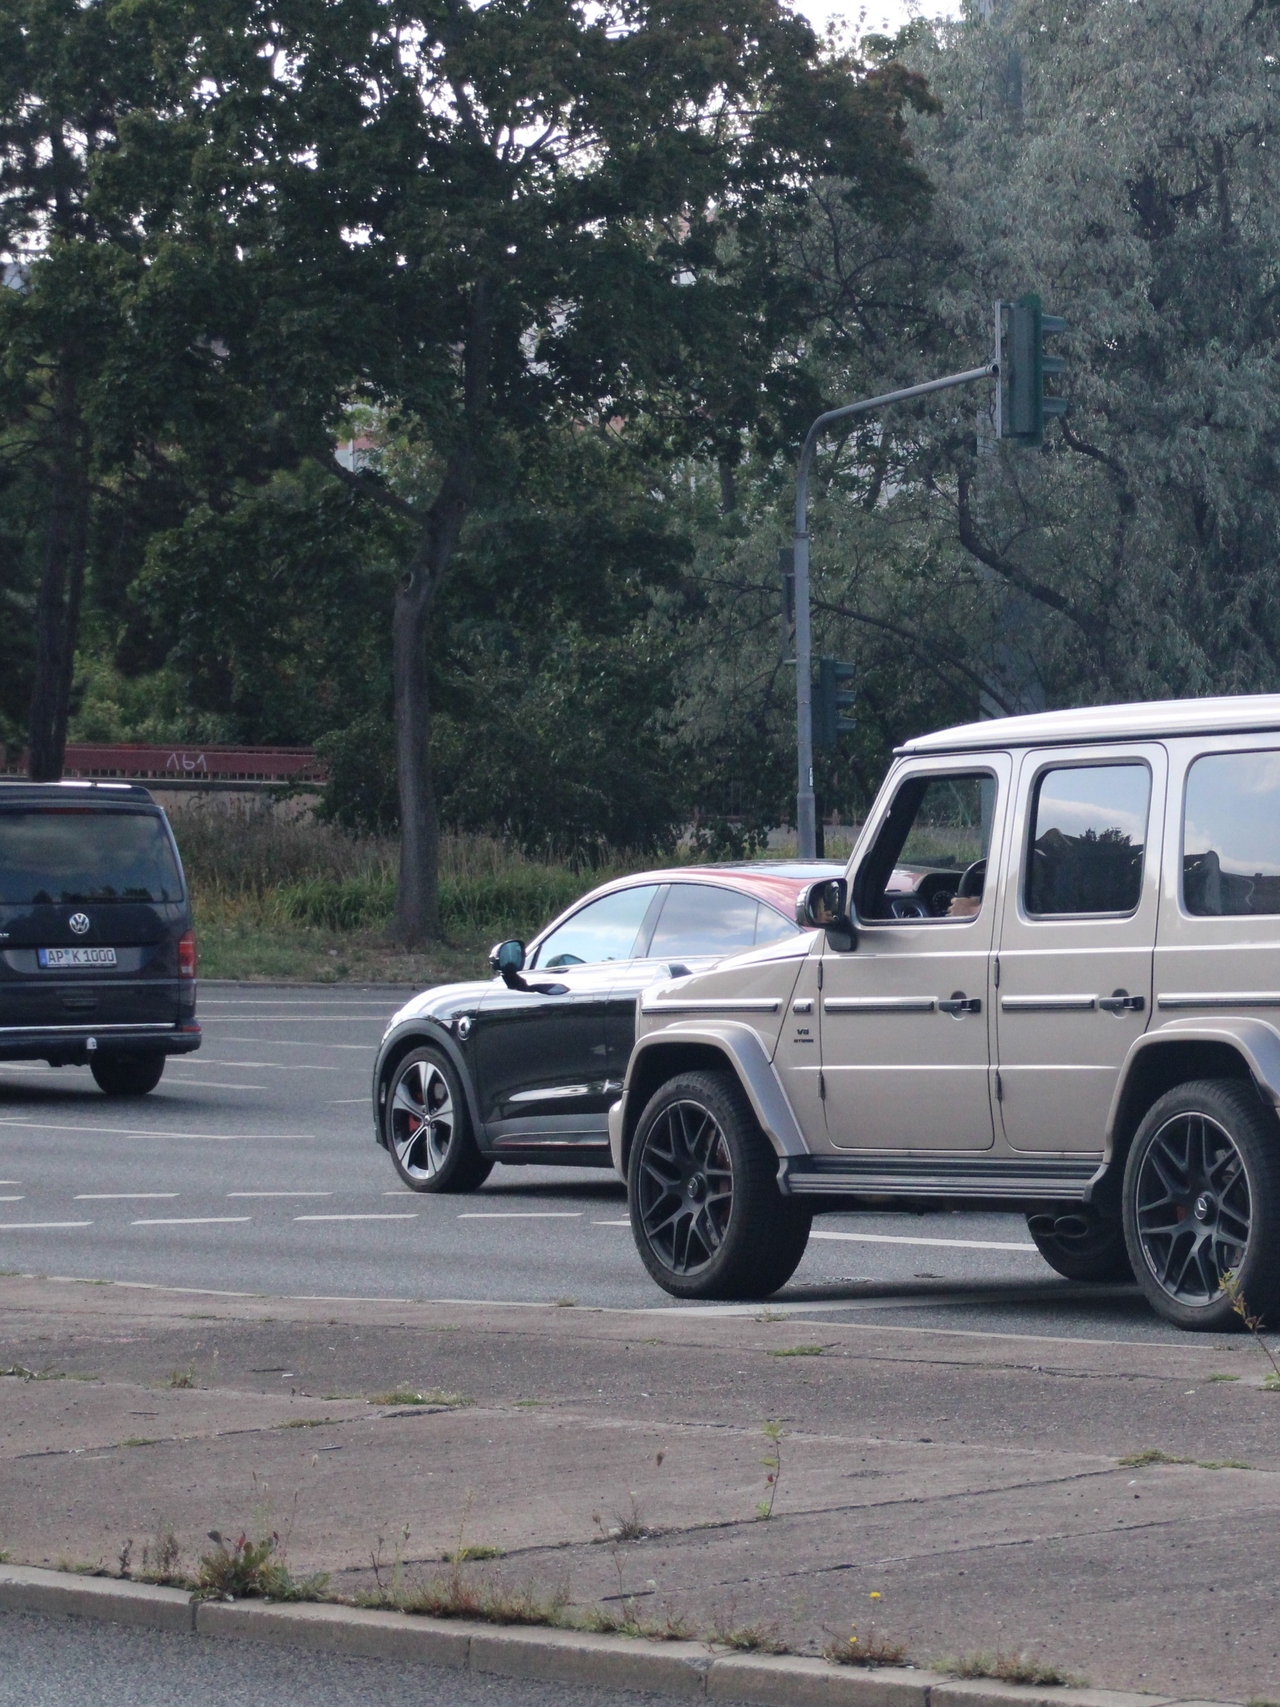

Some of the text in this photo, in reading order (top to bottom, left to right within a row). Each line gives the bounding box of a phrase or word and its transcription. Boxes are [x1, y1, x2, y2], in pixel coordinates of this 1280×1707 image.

[48, 949, 115, 963] AP K 1000
